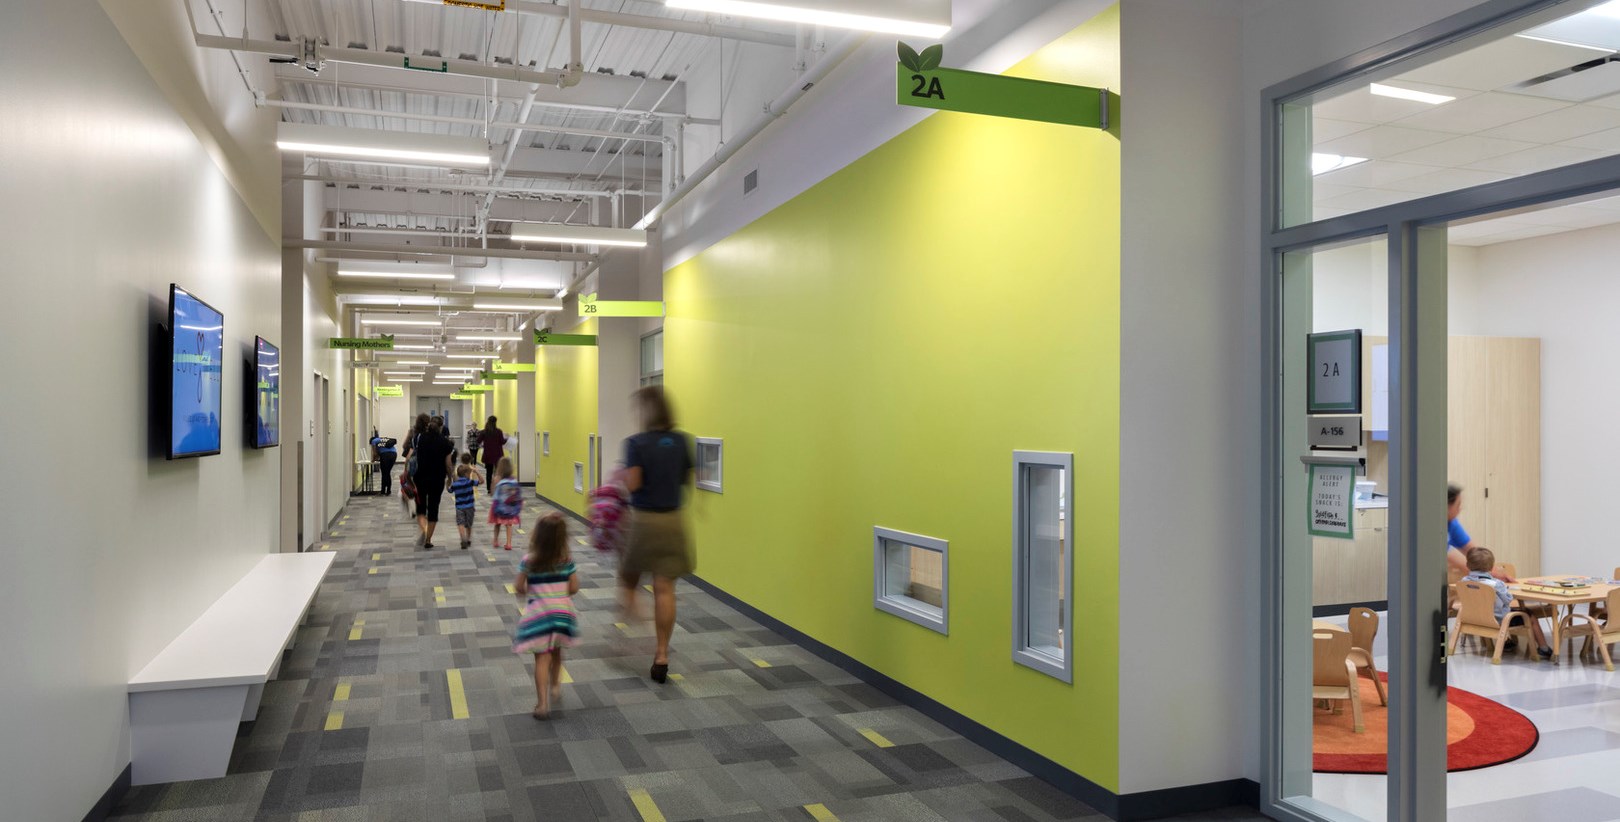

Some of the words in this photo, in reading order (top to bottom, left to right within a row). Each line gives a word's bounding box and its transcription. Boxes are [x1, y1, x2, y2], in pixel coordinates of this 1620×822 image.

[911, 74, 945, 100] 2A
[584, 304, 597, 313] 2B
[334, 340, 361, 348] Nursing
[1320, 427, 1344, 436] A-156
